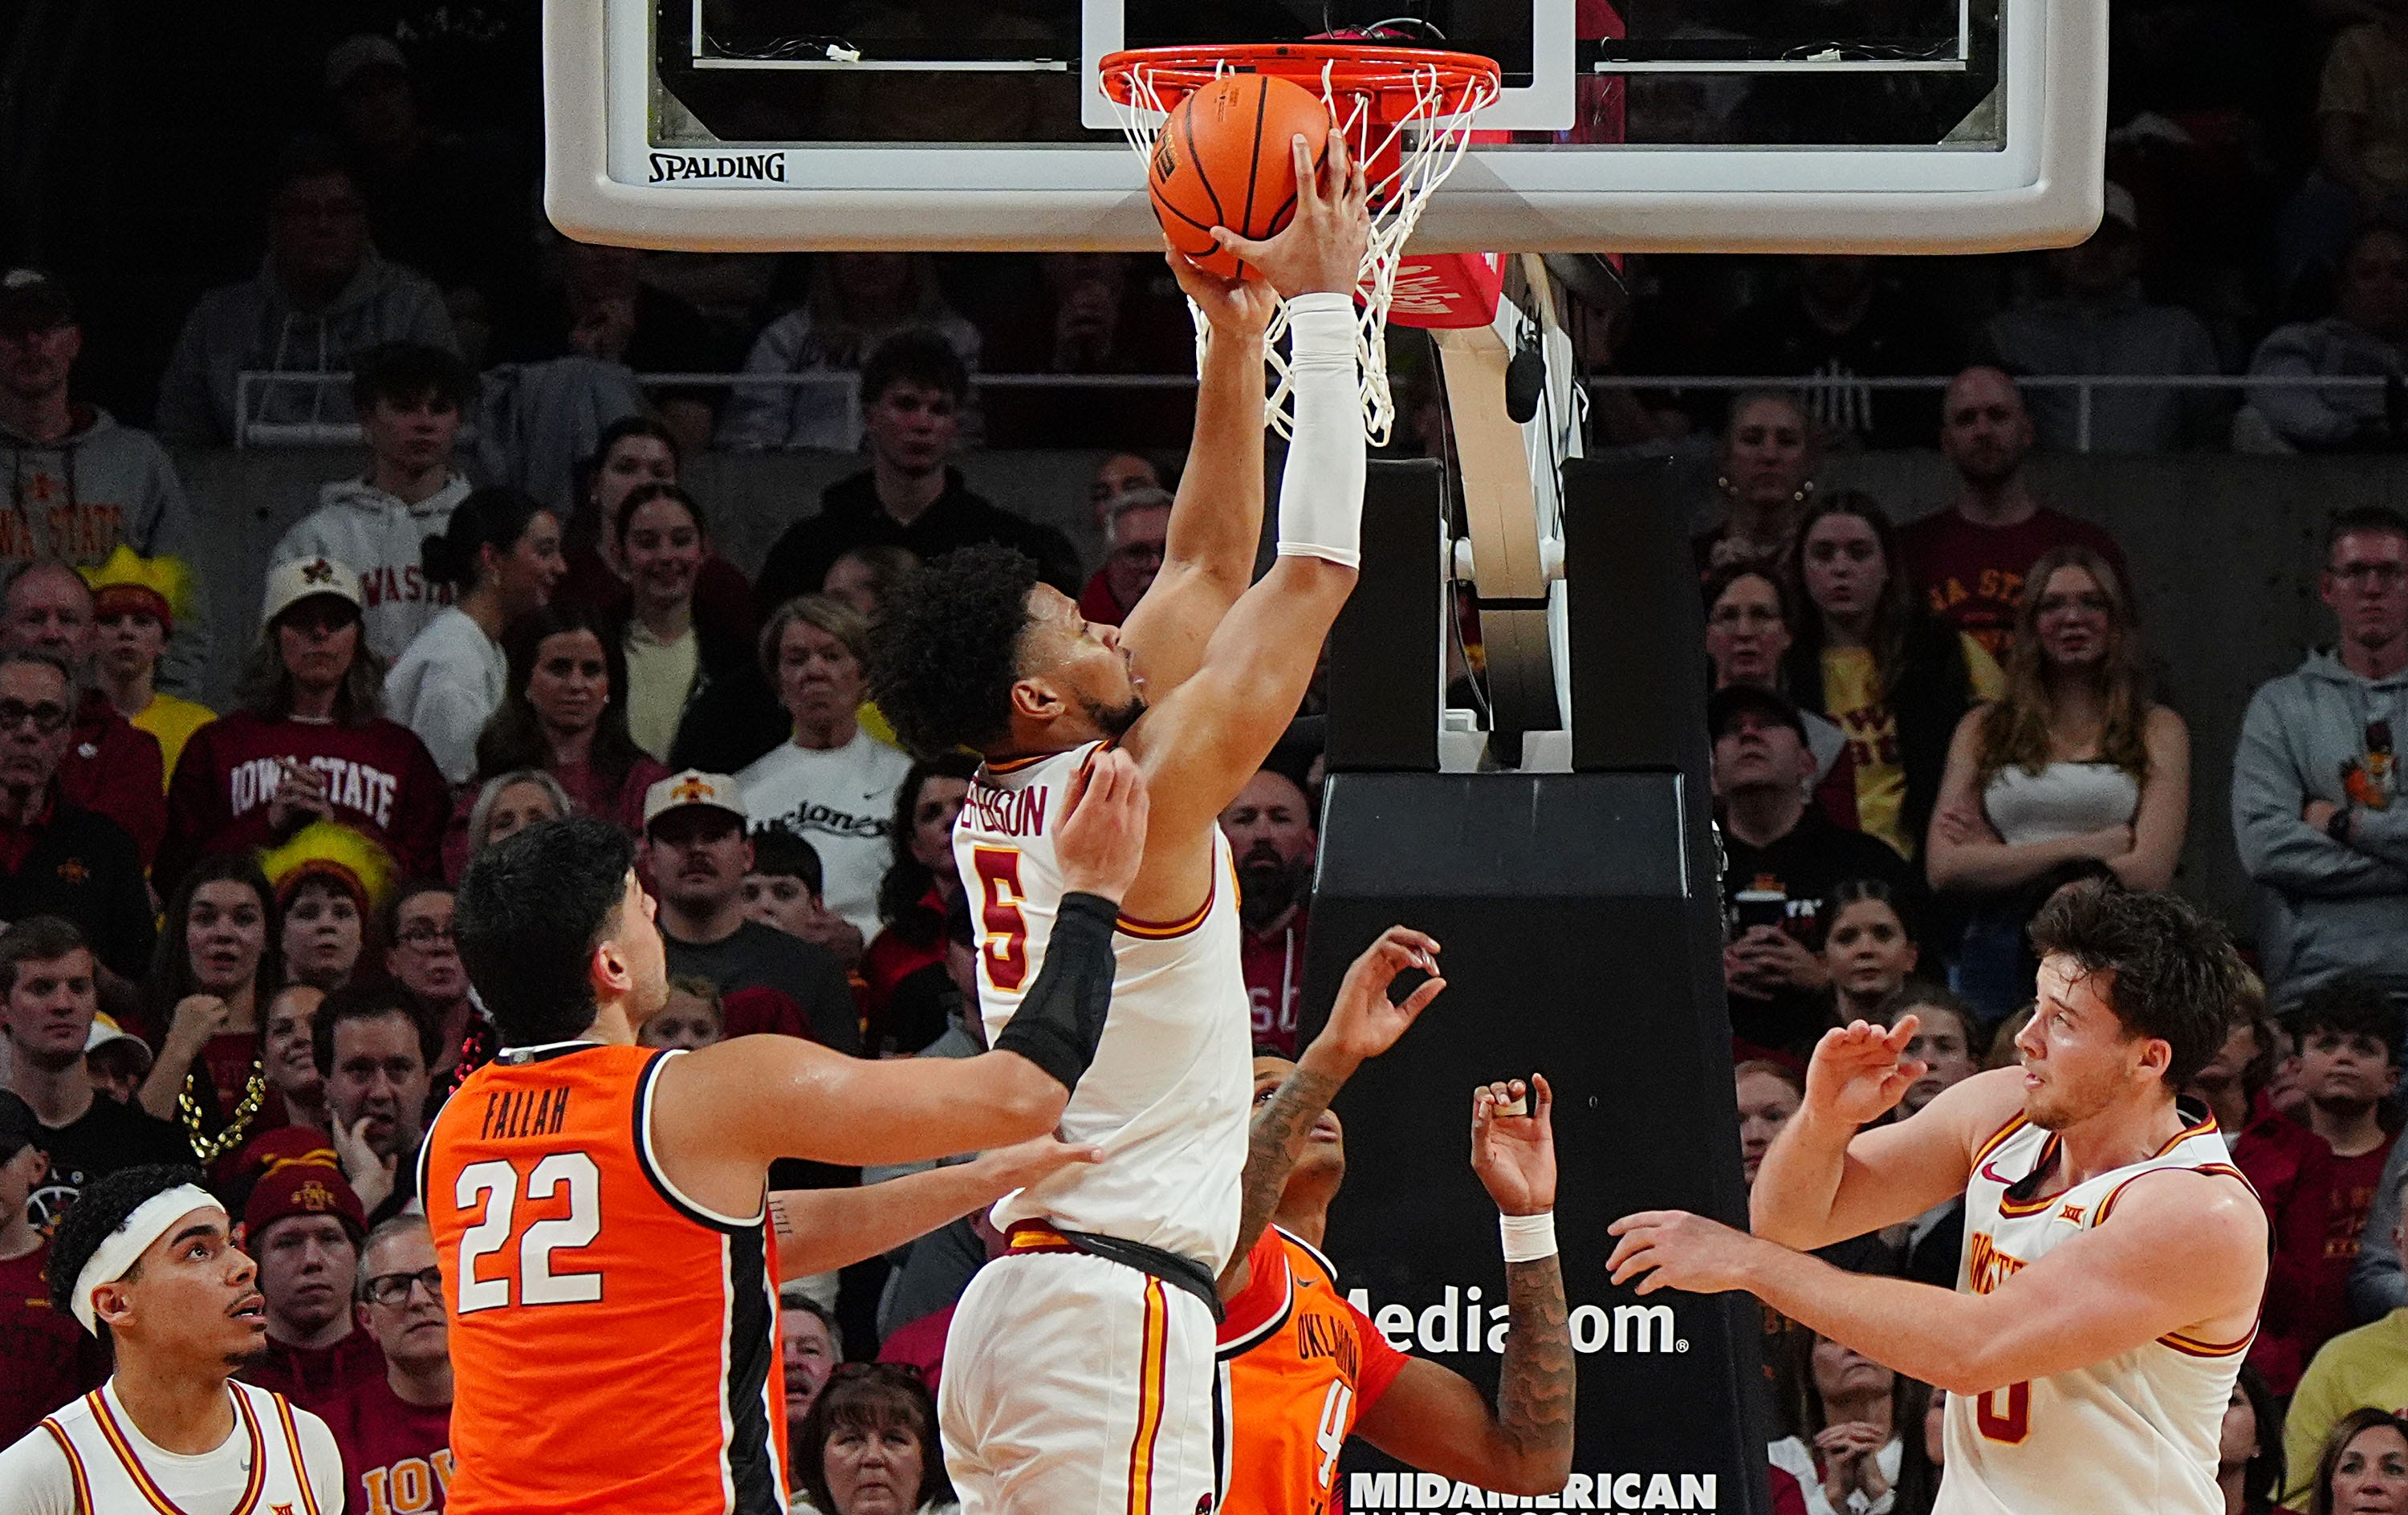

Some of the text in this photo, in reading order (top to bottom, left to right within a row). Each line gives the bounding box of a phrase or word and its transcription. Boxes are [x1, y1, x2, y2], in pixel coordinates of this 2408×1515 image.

[649, 152, 785, 184] SPALDING
[230, 755, 299, 818] IOW
[973, 845, 1029, 993] 5
[481, 1086, 571, 1141] FALLAH
[454, 1150, 603, 1316] 22
[1348, 1286, 1675, 1354] ediaom
[1316, 1377, 1353, 1490] 4
